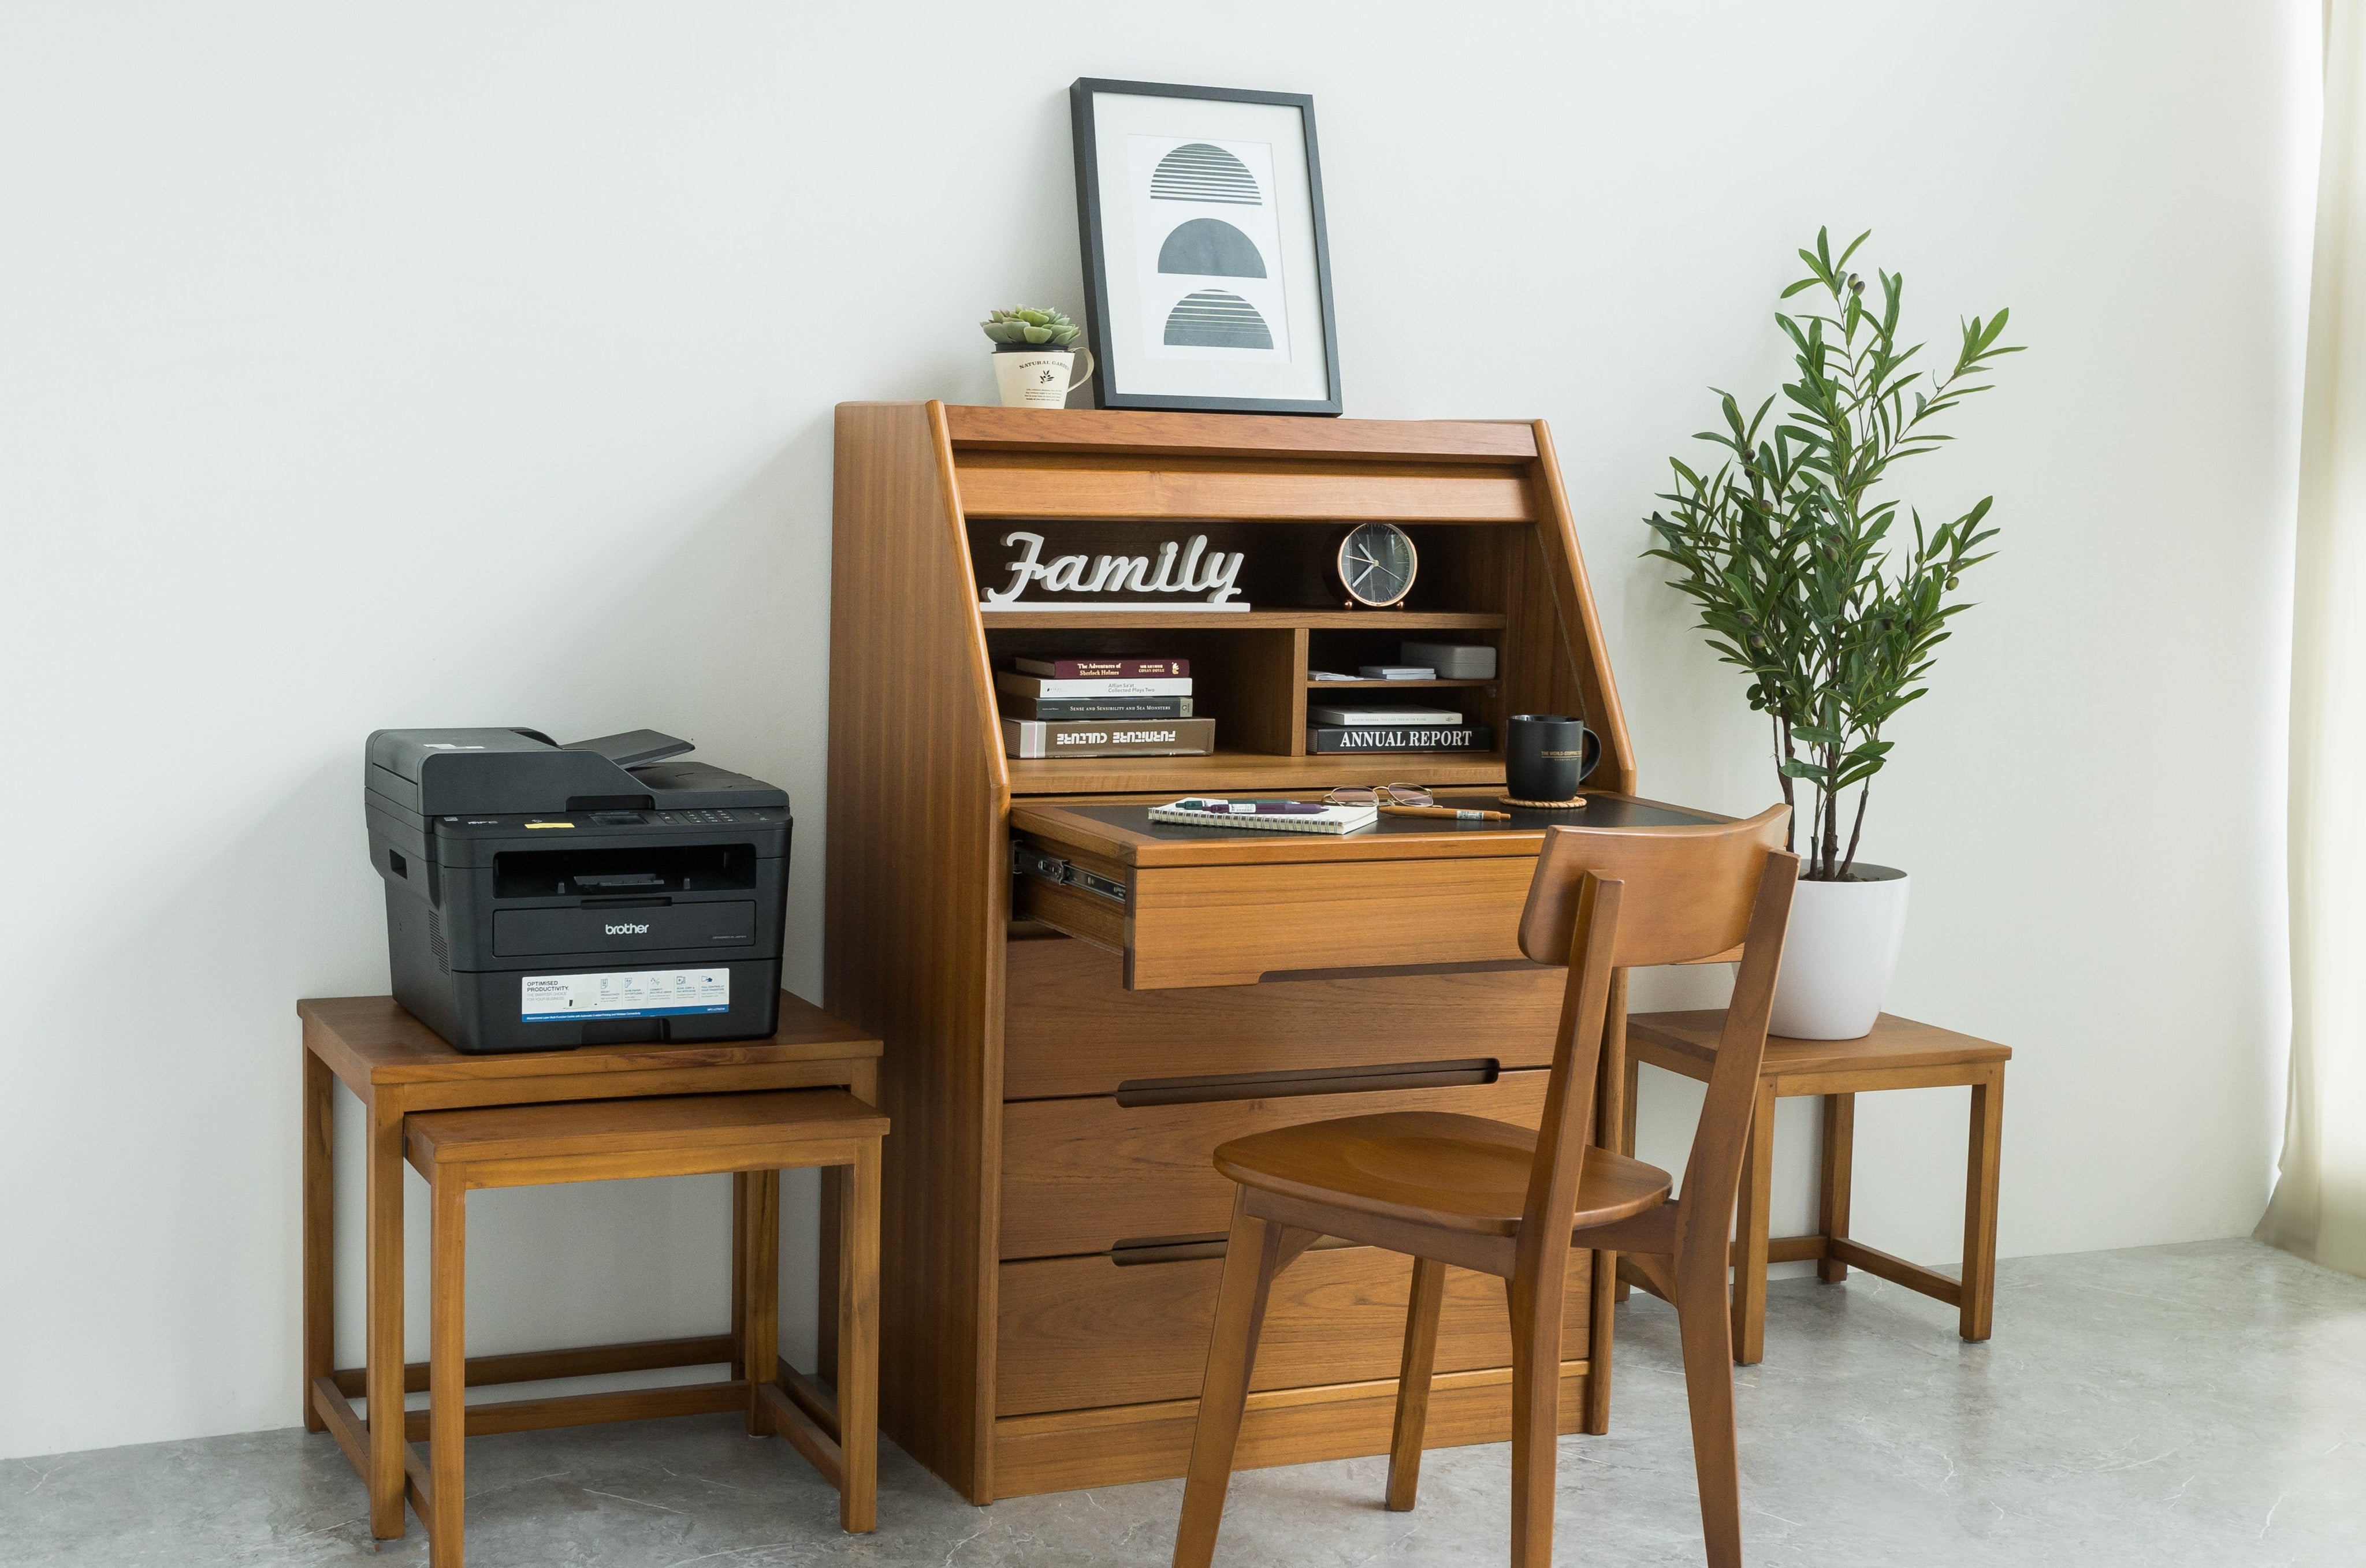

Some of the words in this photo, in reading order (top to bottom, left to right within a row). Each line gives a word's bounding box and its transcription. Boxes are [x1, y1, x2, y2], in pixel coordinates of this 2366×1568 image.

[1019, 361, 1050, 369] NATURAL
[984, 531, 1244, 604] Family
[1340, 731, 1406, 747] ANNUAL
[1408, 731, 1472, 746] REPORT
[605, 923, 649, 934] brother
